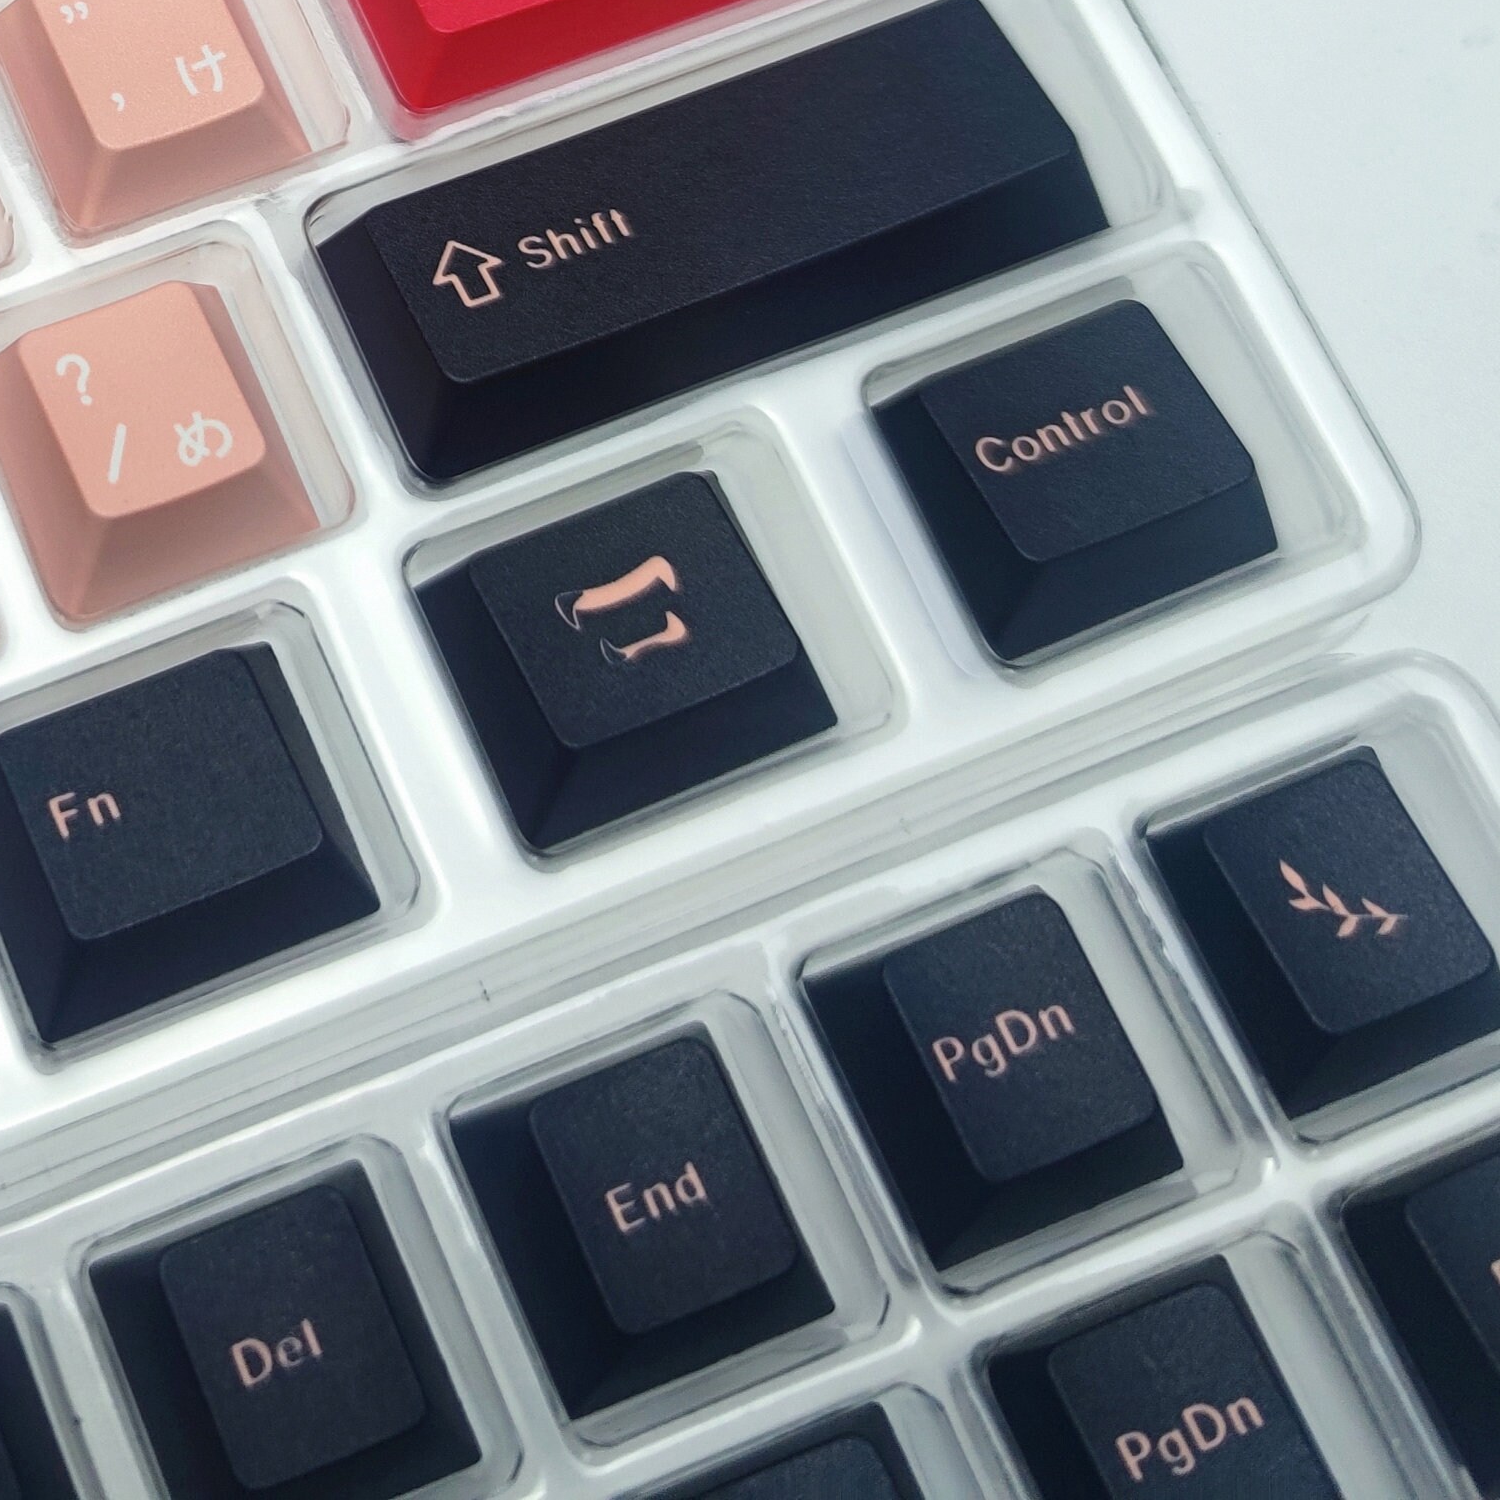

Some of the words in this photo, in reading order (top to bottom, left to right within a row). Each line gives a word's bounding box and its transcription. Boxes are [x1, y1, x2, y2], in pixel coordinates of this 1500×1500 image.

[175, 44, 227, 96] け
[517, 207, 634, 271] Shift
[55, 352, 93, 405] ?
[174, 411, 234, 468] め
[974, 385, 1152, 473] Control
[47, 788, 123, 840] Fn
[930, 1002, 1076, 1083] PgDn
[604, 1161, 708, 1236] End
[229, 1317, 323, 1389] Del
[1114, 1396, 1264, 1482] PgDn
